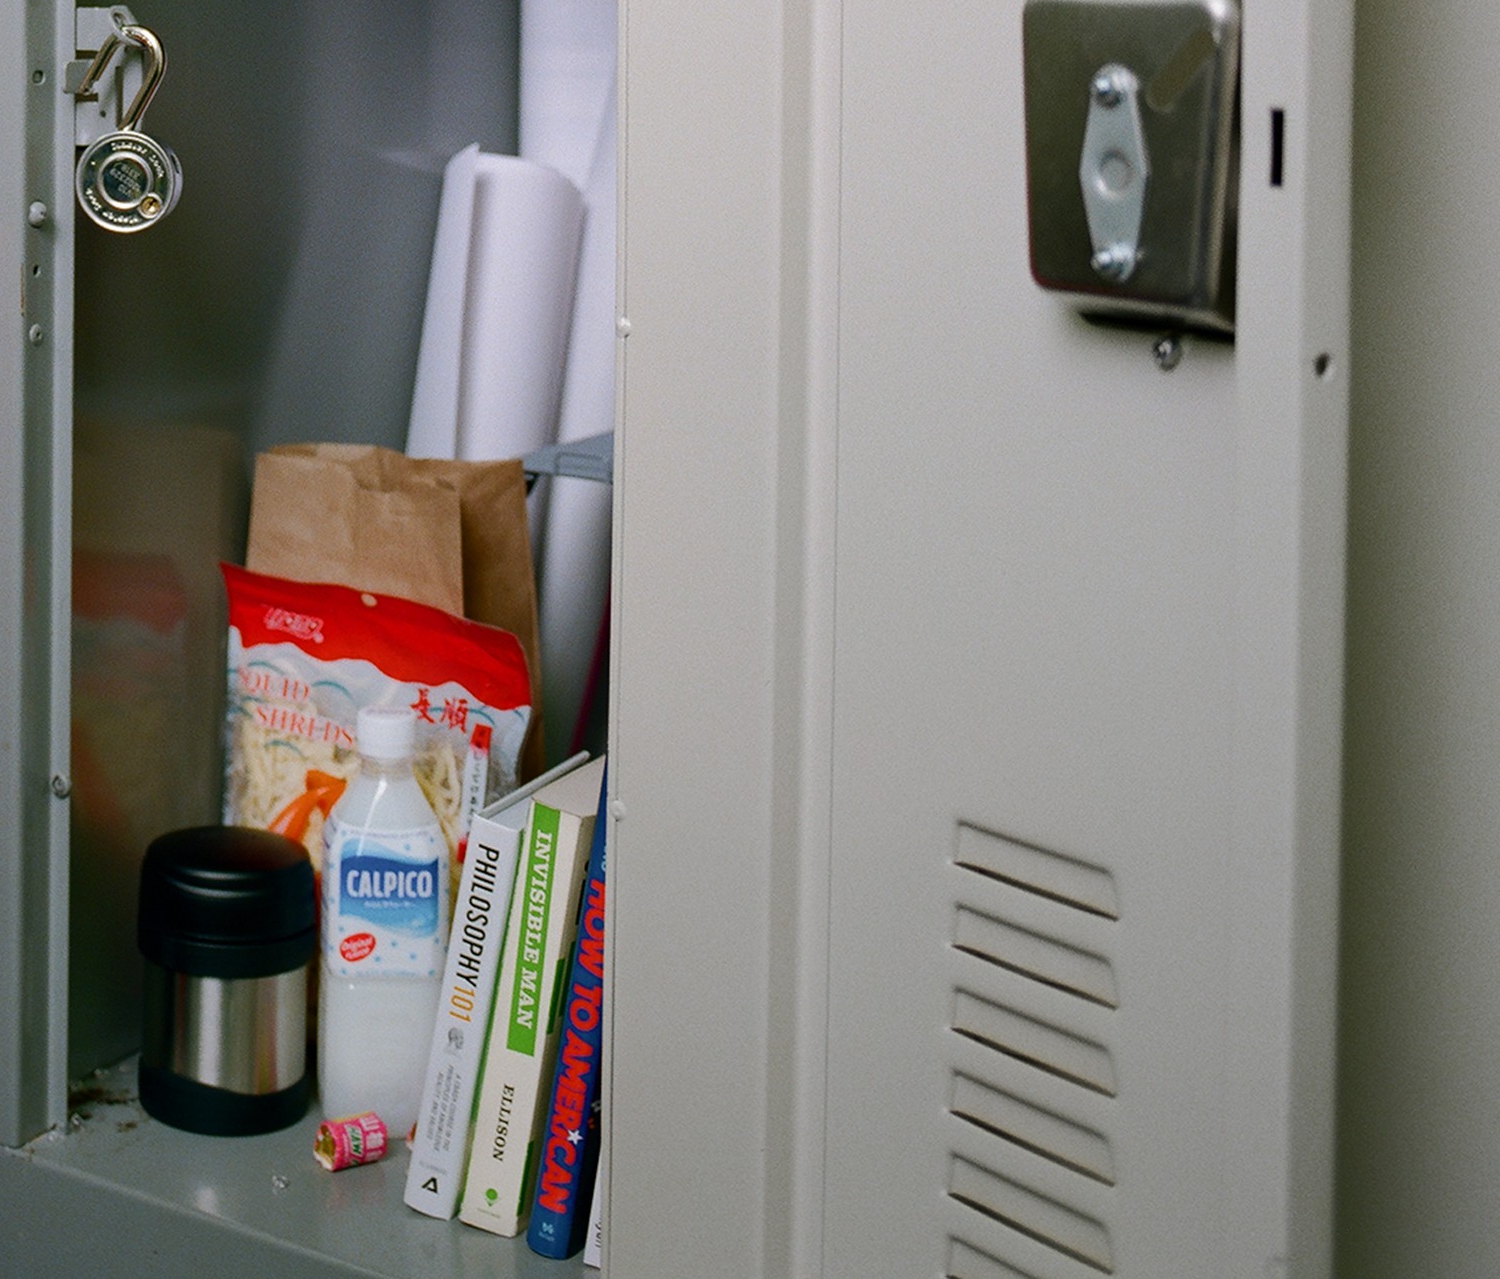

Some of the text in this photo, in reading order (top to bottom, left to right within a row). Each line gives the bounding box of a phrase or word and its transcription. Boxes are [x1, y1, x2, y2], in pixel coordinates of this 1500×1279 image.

[255, 705, 355, 750] SHREDS
[346, 869, 433, 899] CALPICO
[455, 843, 500, 988] PHILOSOPHY
[516, 829, 553, 1030] INVISIBLE MAN
[578, 878, 606, 979] HOW
[448, 985, 476, 1023] 101
[569, 982, 603, 1032] TO
[492, 1083, 515, 1162] ELLISON
